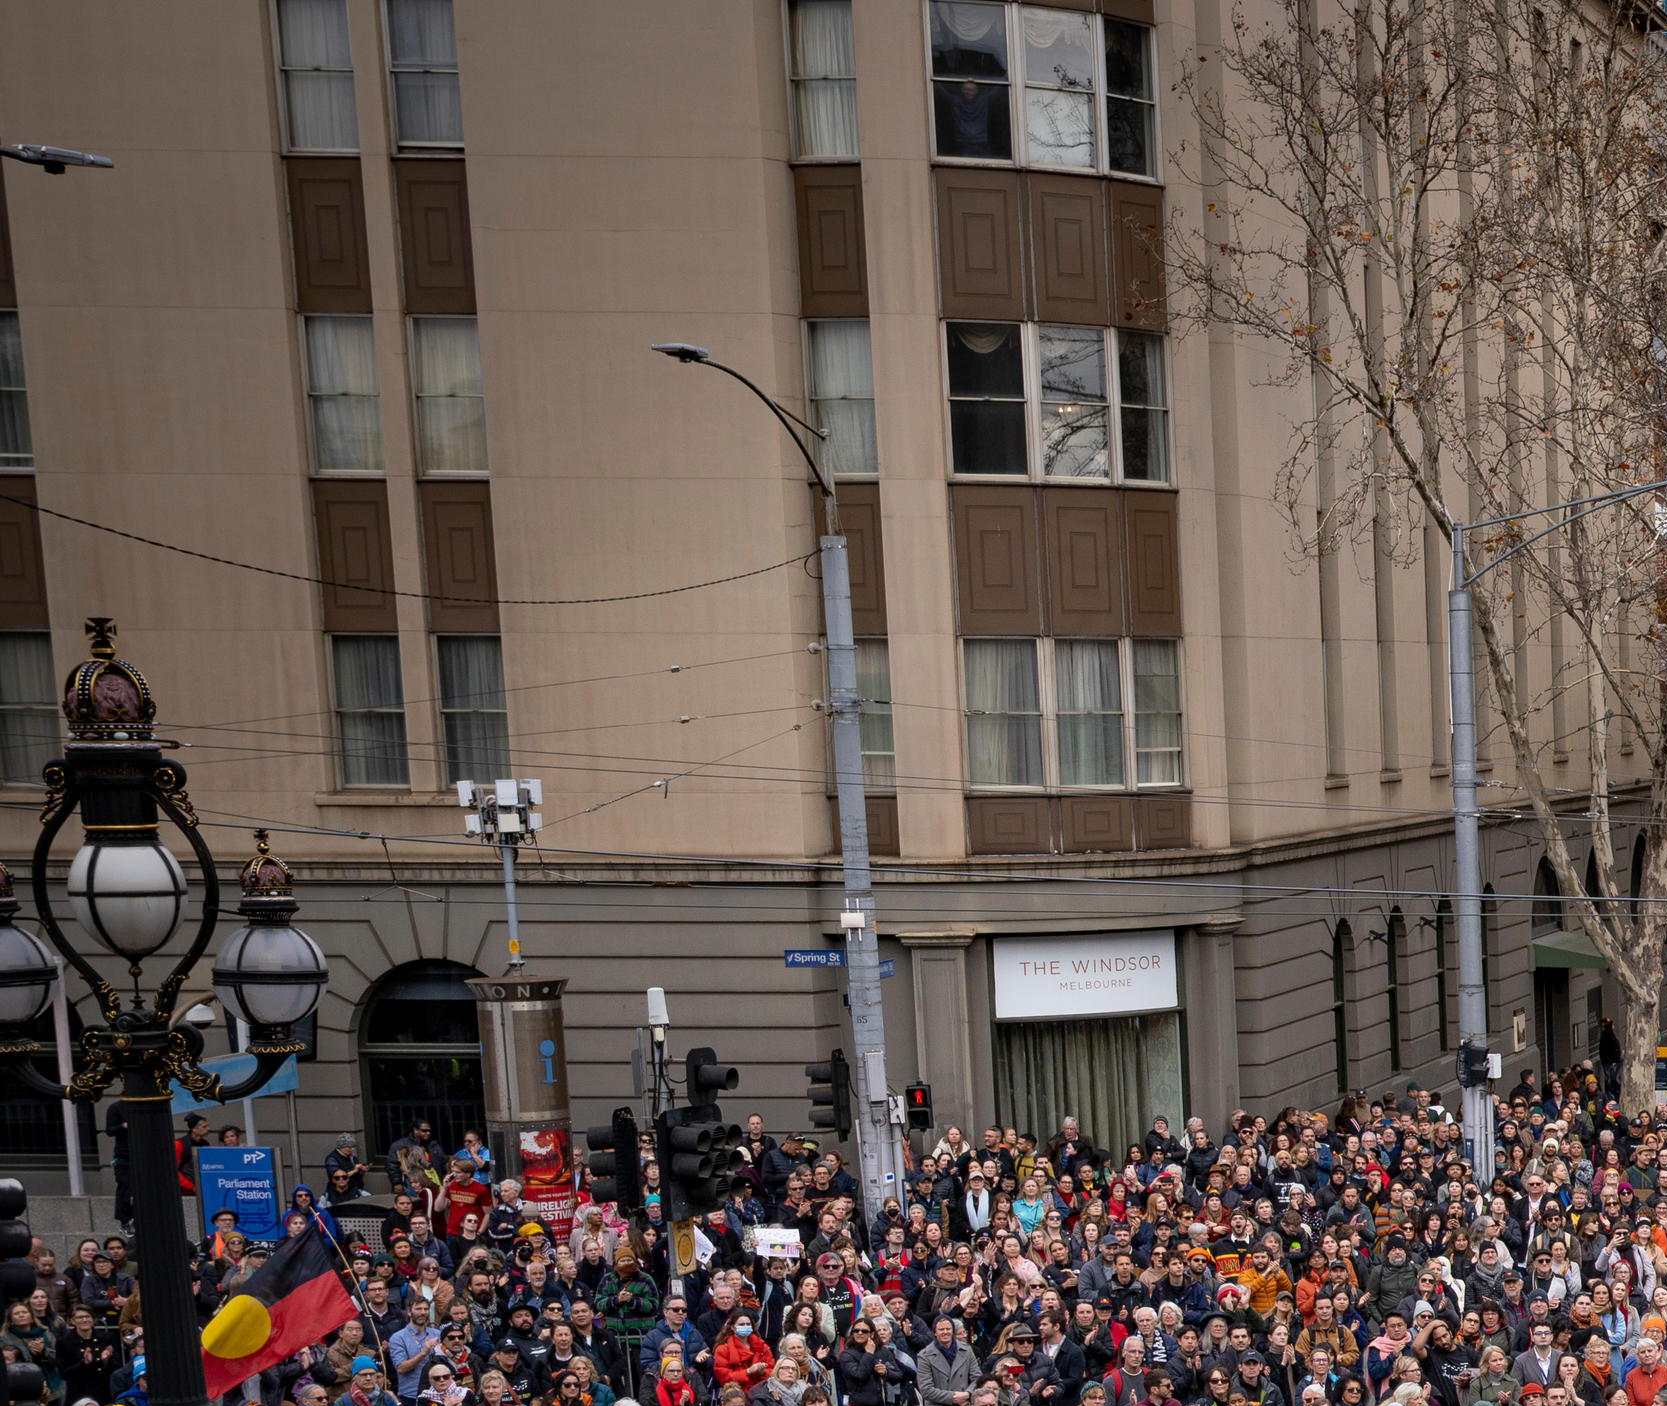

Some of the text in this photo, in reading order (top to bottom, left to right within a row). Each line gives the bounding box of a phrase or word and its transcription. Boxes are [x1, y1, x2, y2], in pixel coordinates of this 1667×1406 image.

[794, 952, 840, 964] Spring St
[1019, 956, 1161, 976] THE WINDSOR
[1060, 978, 1133, 991] MELBOURNE
[218, 1178, 270, 1189] Parliament
[236, 1190, 272, 1200] Station
